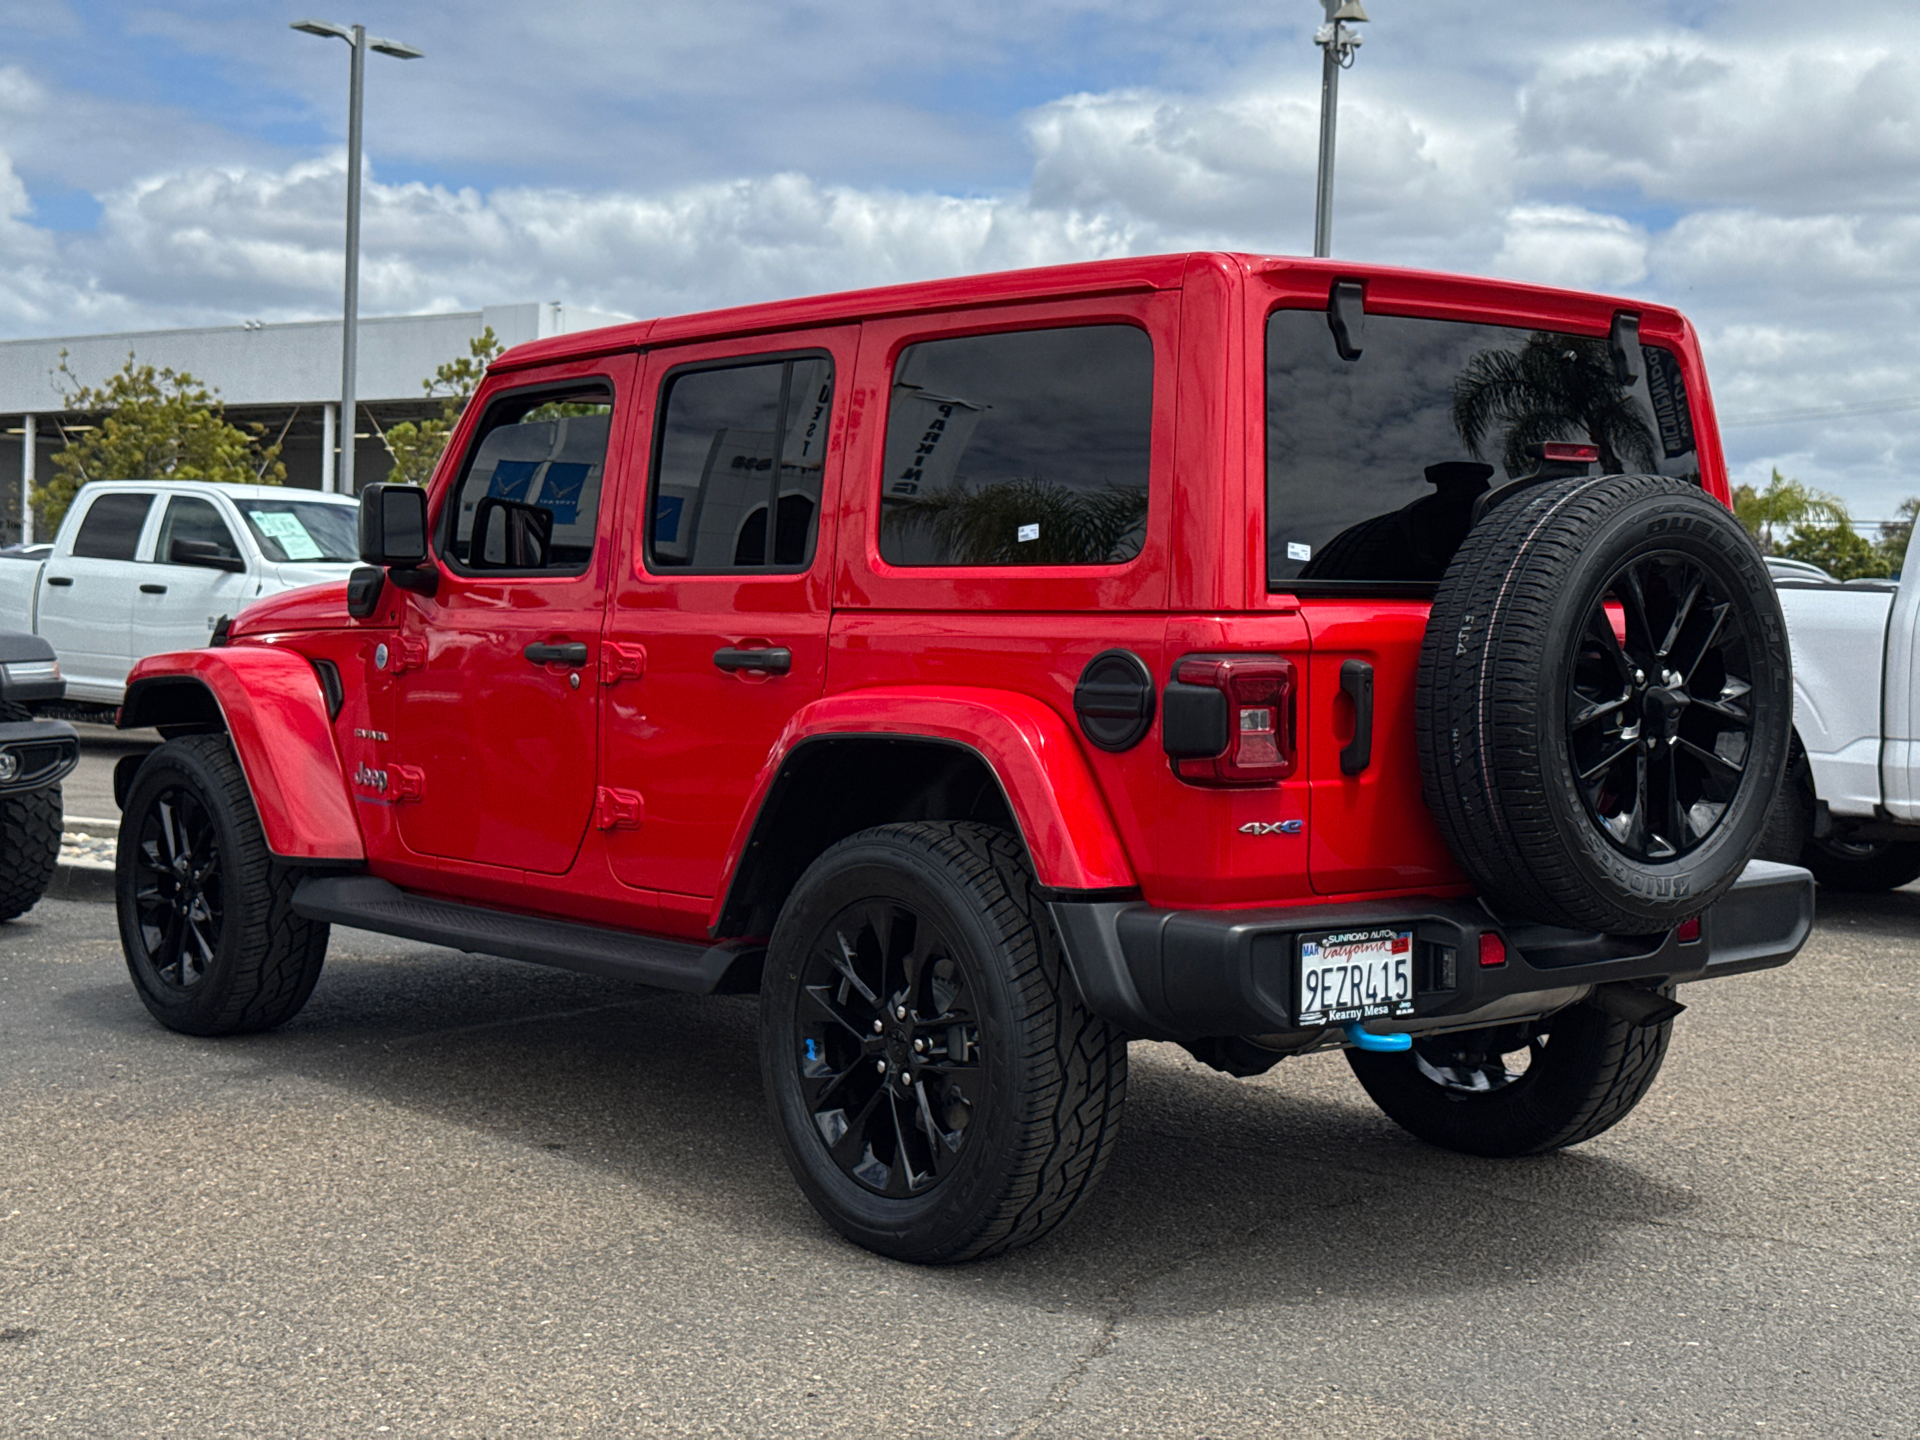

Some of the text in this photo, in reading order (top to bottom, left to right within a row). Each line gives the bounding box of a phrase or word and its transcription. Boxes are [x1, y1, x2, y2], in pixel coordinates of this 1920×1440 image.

[1647, 517, 1763, 594] DUELER
[354, 761, 388, 794] Jeep
[1328, 929, 1391, 944] SUNROAD AUTO
[1303, 944, 1319, 956] MAR
[1322, 941, 1393, 963] California
[1305, 959, 1408, 1012] 9EZR415
[1329, 1009, 1362, 1021] Kearny
[1364, 1005, 1389, 1016] Mesa
